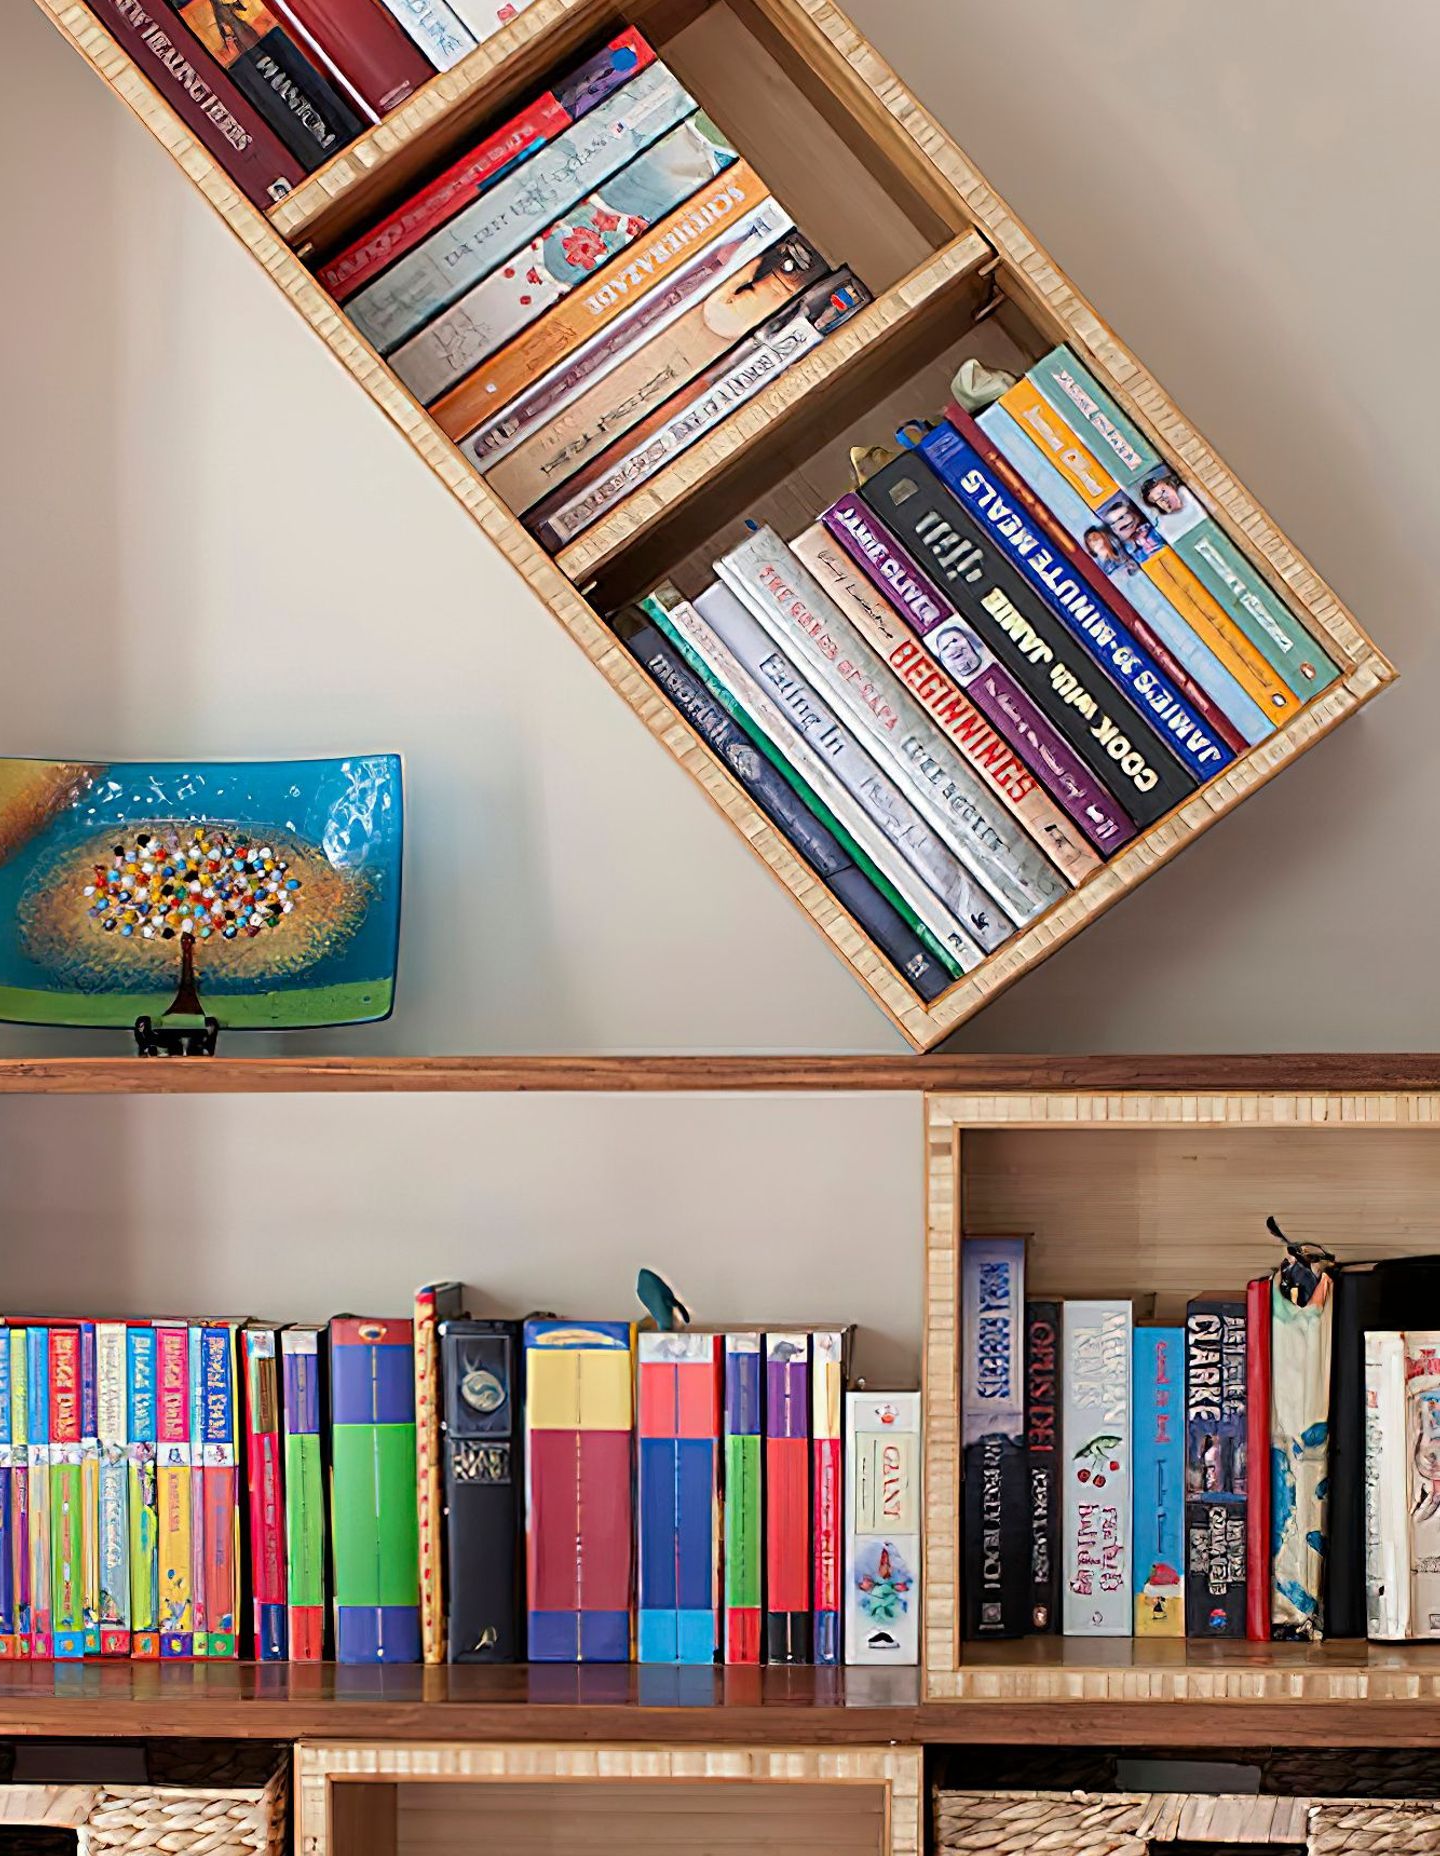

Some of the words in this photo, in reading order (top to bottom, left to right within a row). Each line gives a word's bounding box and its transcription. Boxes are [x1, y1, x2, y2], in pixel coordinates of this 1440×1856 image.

[960, 468, 1037, 551] MEALS
[976, 584, 1058, 671] JAMIE
[888, 640, 1041, 804] BEGINNINGS
[1088, 714, 1160, 792] COOK
[1130, 667, 1225, 769] JAMIE'S
[1188, 1313, 1222, 1422] CLARKE
